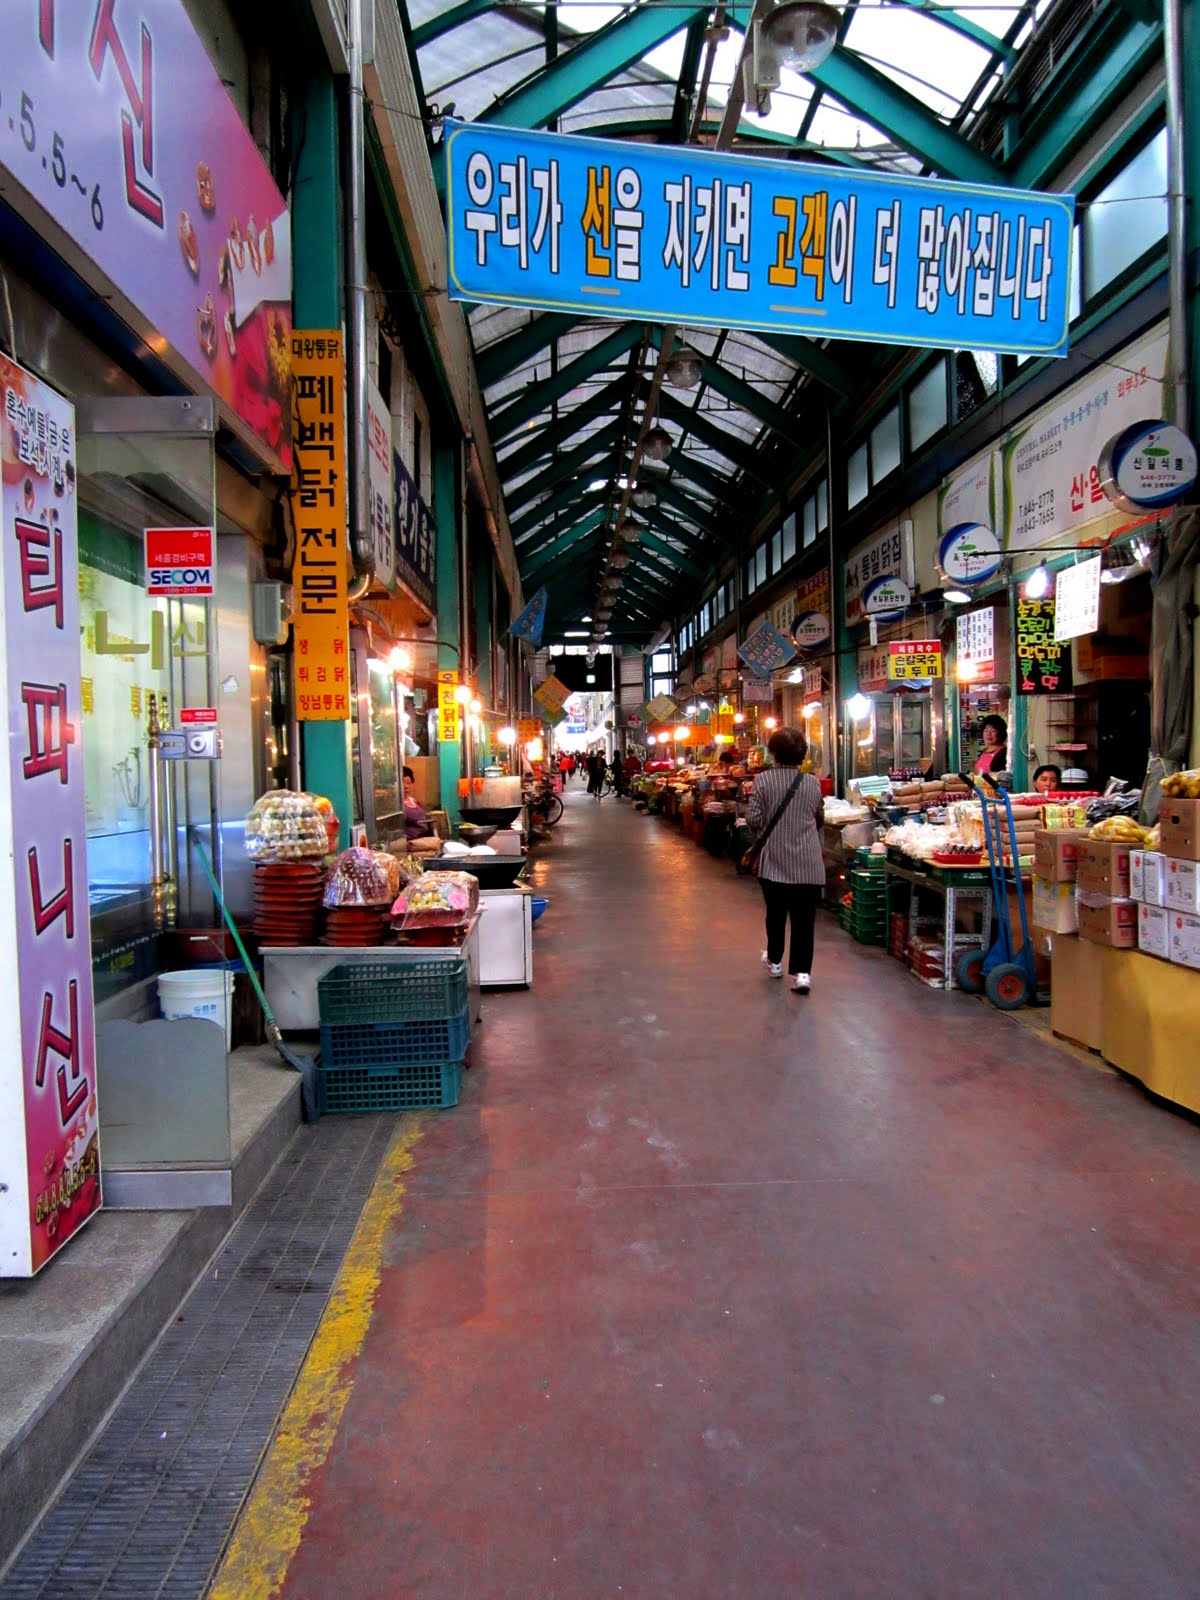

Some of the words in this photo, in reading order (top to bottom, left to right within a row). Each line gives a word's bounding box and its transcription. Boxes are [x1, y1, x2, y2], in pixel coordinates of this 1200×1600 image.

[464, 151, 563, 274] 우리가
[581, 166, 644, 281] 선을
[662, 174, 752, 291] 지키면
[768, 191, 857, 304] 고객이
[872, 200, 900, 308] 더
[917, 205, 1052, 322] 많아집니다
[292, 339, 339, 359] 대왕통닭
[1133, 457, 1183, 471] 신일식품
[155, 553, 205, 563] 세콤경비구역
[150, 569, 210, 585] SECOM
[895, 654, 938, 666] 손칼국수
[299, 695, 345, 711] 양념통닭
